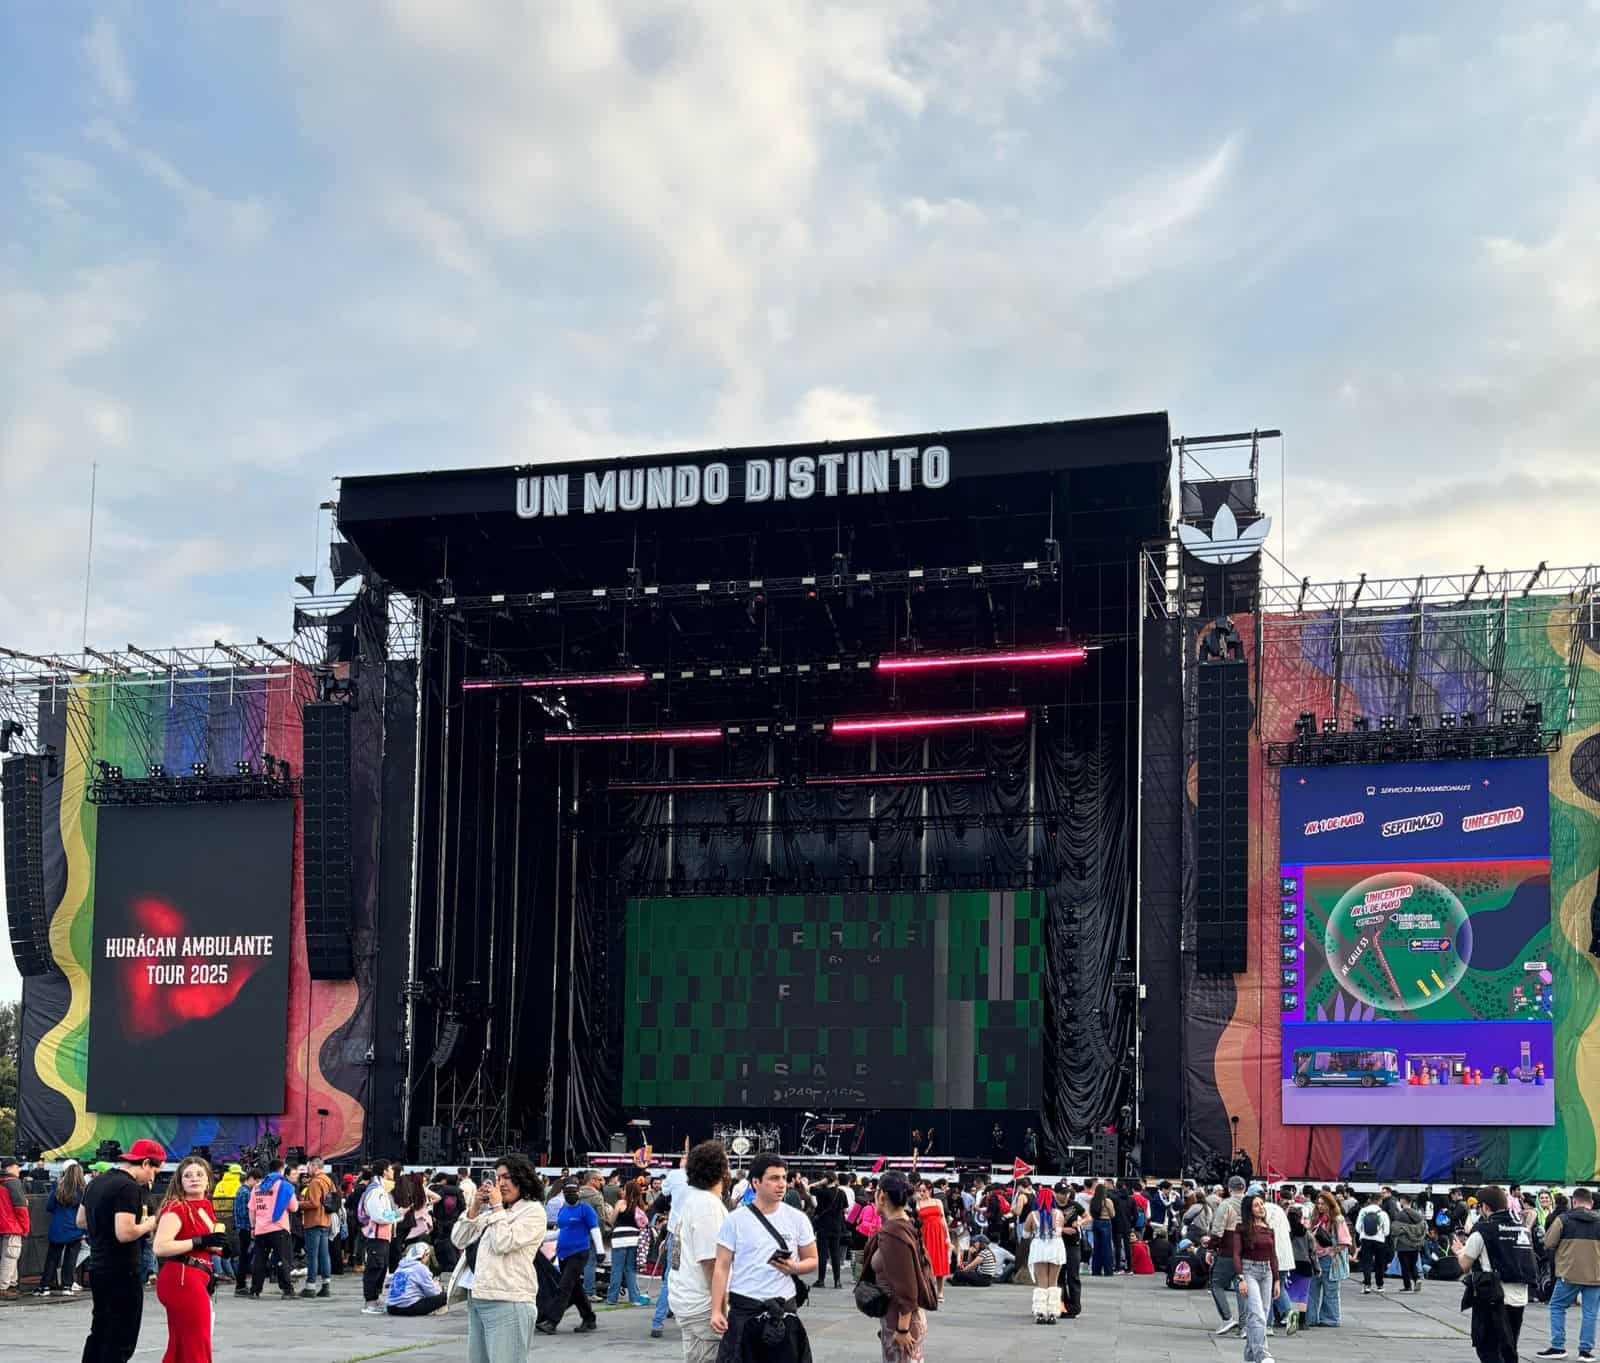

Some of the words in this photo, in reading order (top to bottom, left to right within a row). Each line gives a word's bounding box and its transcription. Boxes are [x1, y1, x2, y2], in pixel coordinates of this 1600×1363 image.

[515, 473, 569, 520] UN
[582, 461, 730, 515] MUNDO
[744, 445, 951, 504] DISTINTO
[1304, 821, 1318, 835] AV.
[1327, 817, 1339, 831] DE
[1340, 812, 1365, 829] MAYO
[1383, 813, 1443, 836] SEPTIMAZO
[1462, 806, 1524, 832] UNICENTRO
[1365, 885, 1413, 904] UNICENTRO
[1369, 902, 1379, 913] DE
[1380, 899, 1401, 911] MAYO
[106, 933, 176, 958] HURÁCAN
[181, 935, 273, 957] AMBULANTE
[147, 965, 185, 985] TOUR
[190, 964, 228, 985] 2025
